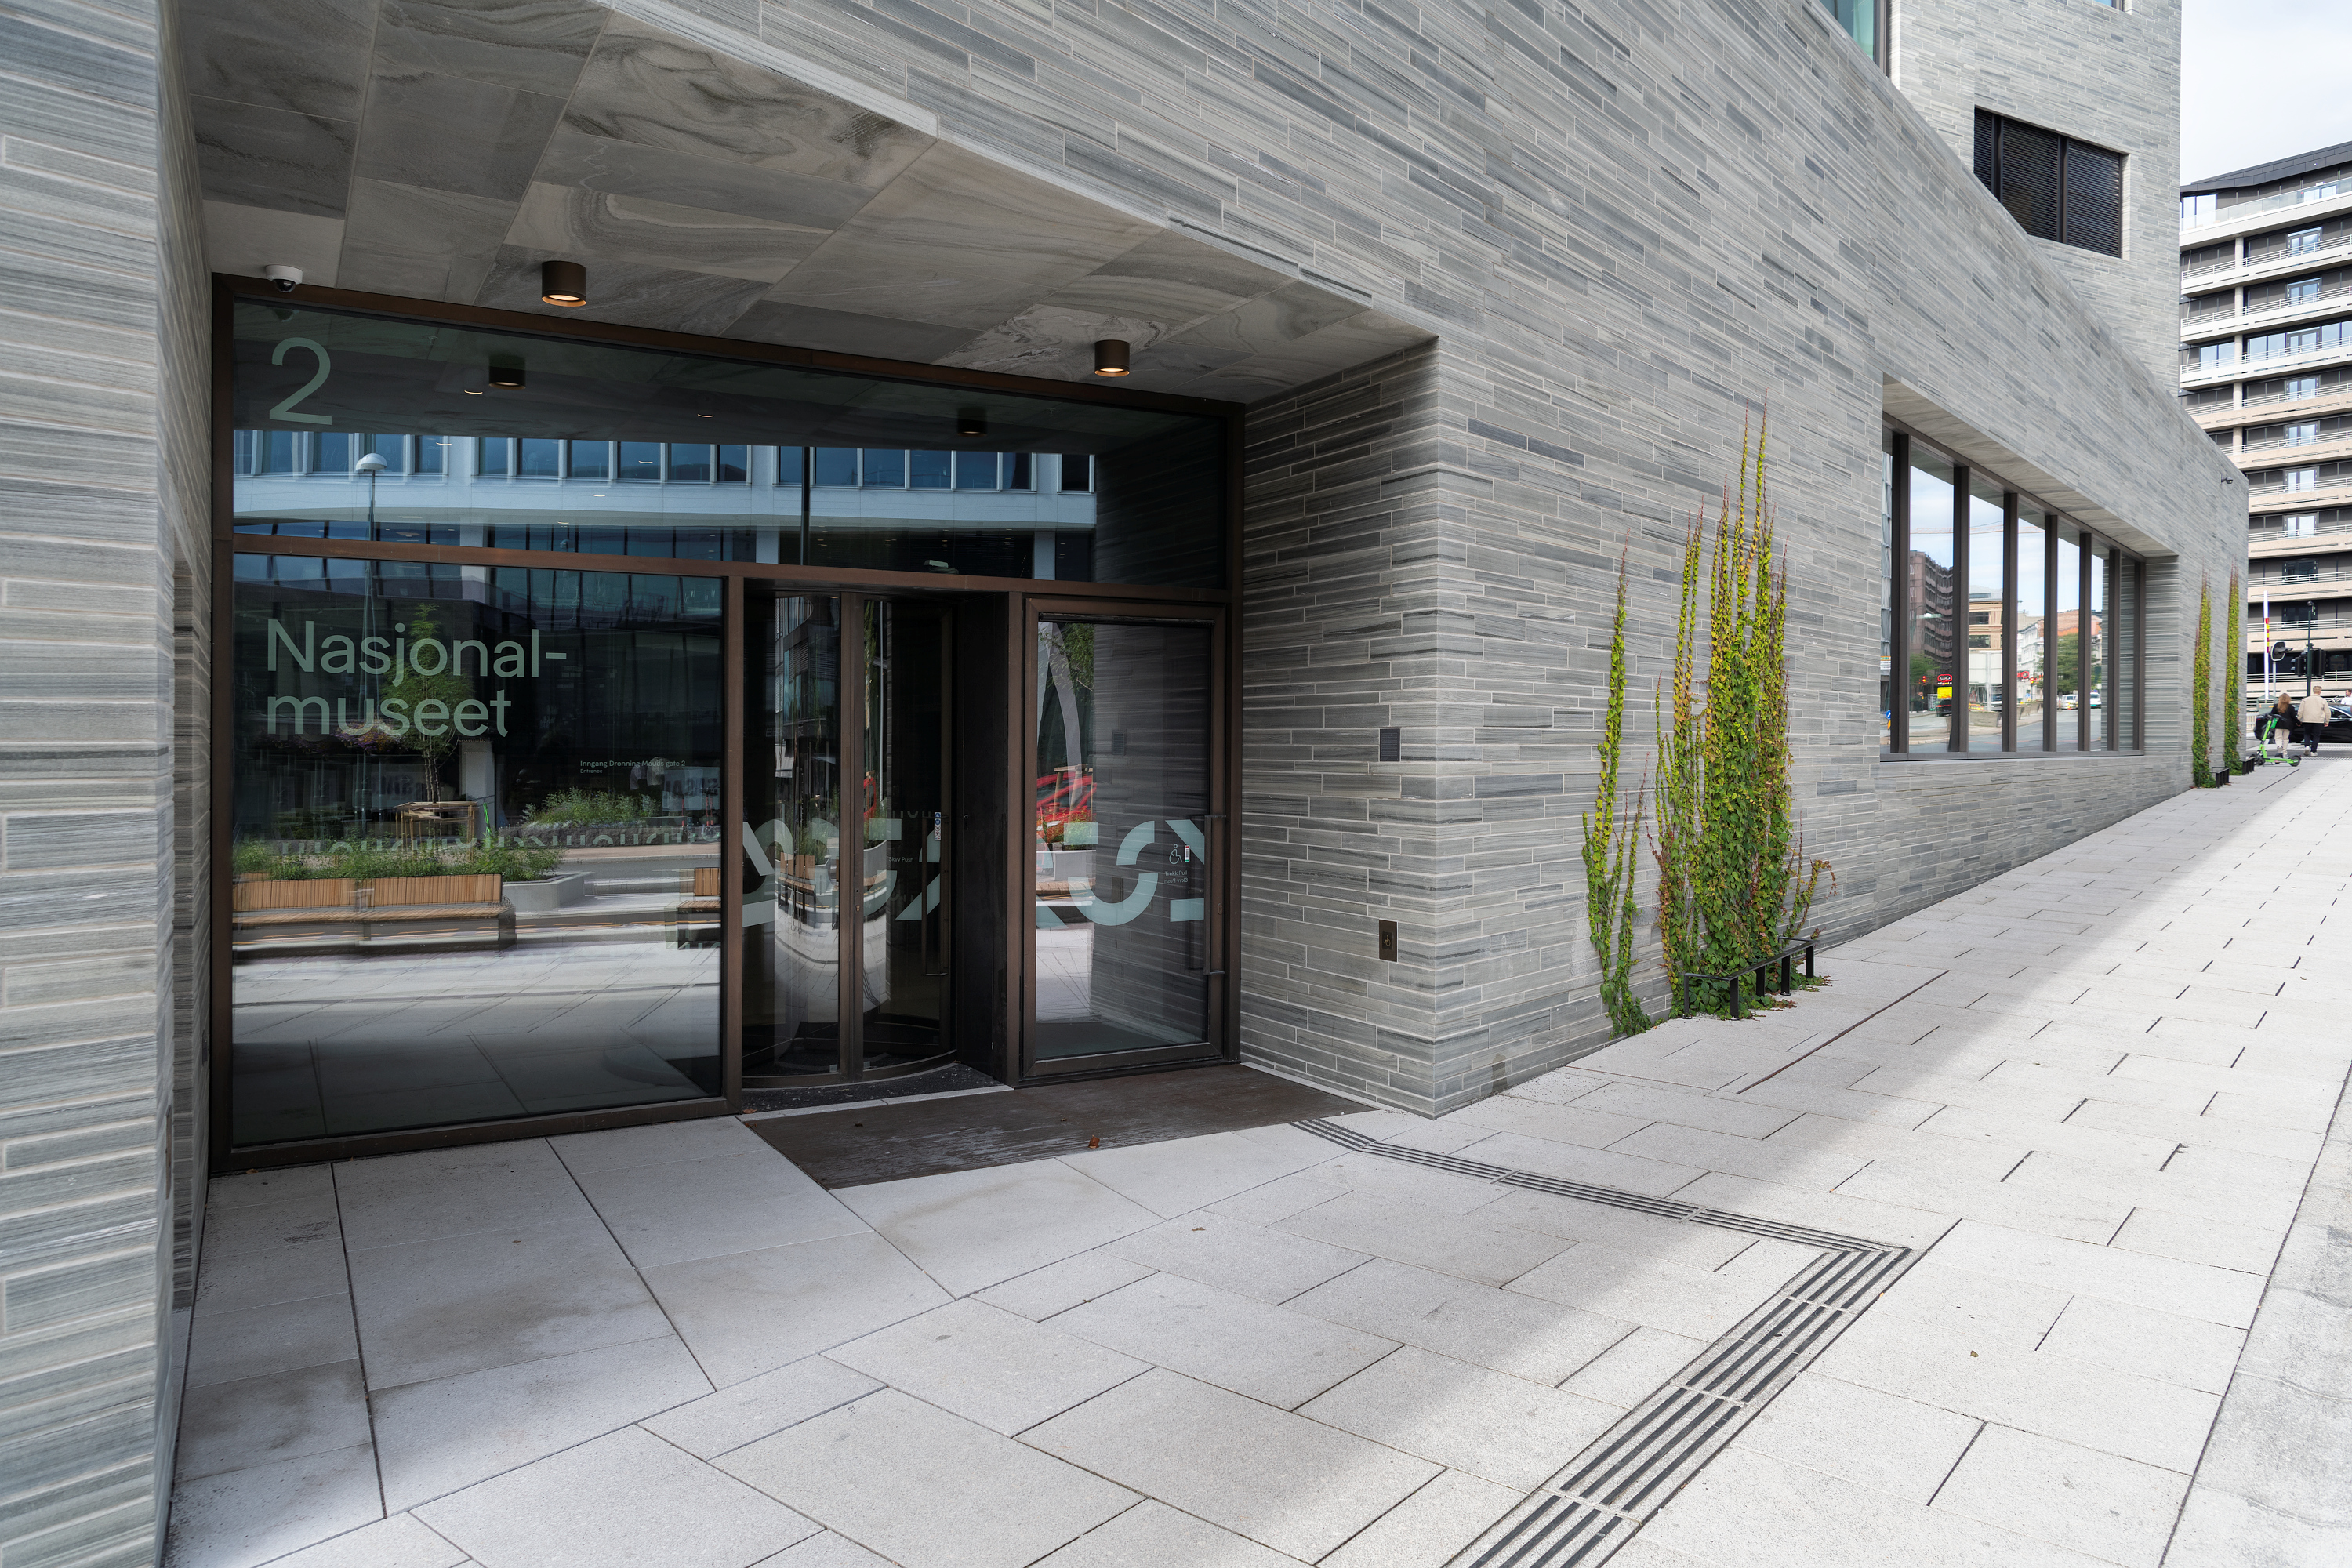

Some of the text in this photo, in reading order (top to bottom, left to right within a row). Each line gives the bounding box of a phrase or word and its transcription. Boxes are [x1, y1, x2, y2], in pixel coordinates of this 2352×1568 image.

[270, 337, 332, 425] 2
[267, 619, 567, 687] Nasjonal-
[267, 689, 511, 737] museet
